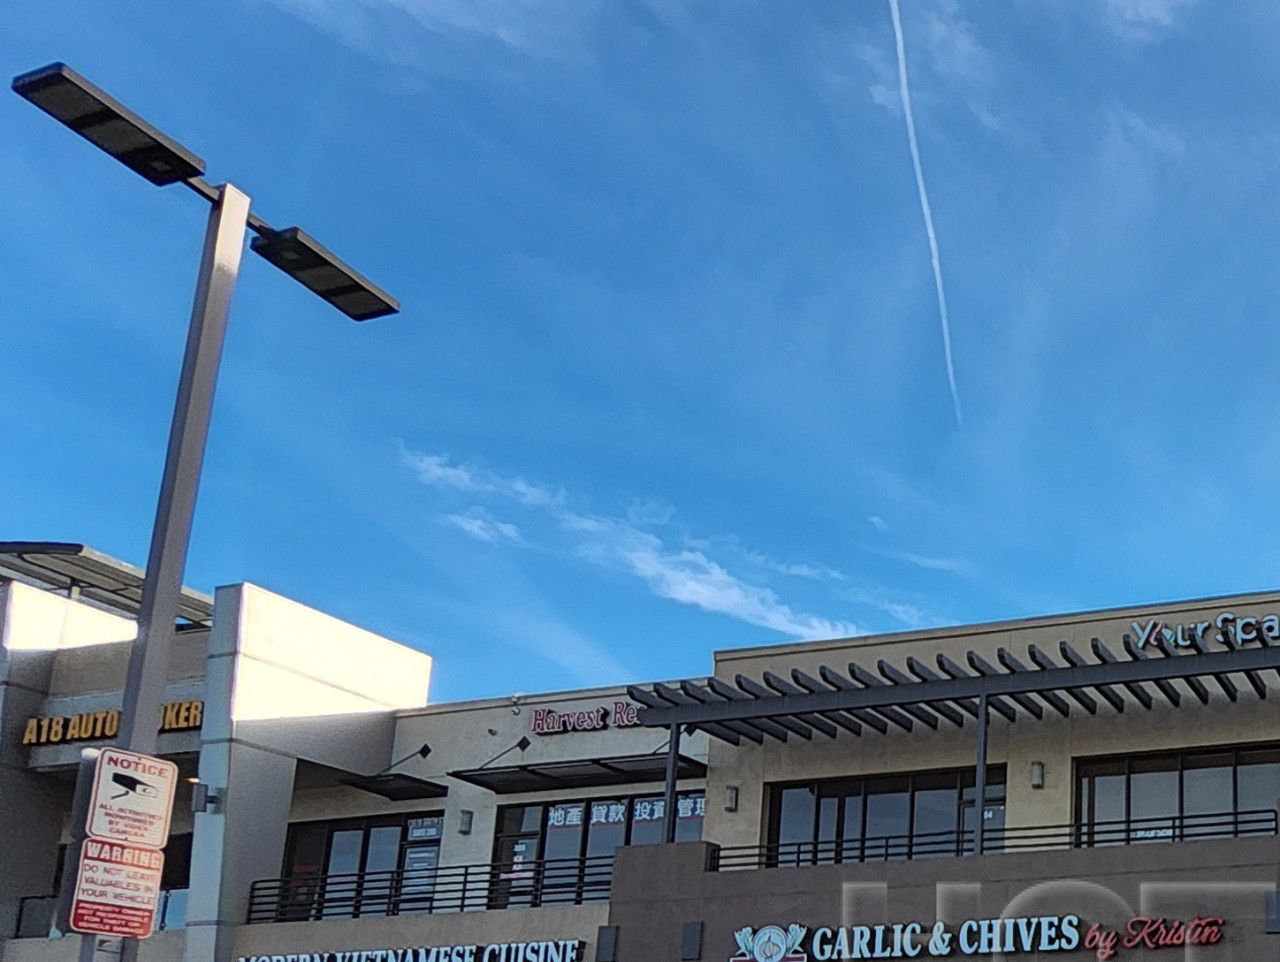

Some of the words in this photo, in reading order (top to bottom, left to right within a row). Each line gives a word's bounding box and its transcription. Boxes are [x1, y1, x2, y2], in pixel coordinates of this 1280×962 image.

[1215, 612, 1280, 646] Spa
[22, 716, 63, 745] A18
[66, 709, 120, 741] AUTO
[160, 701, 202, 730] KER
[531, 706, 604, 733] Harvest
[107, 755, 169, 779] NOTICE
[548, 806, 582, 826] 地產
[590, 804, 625, 823] 貸款
[87, 841, 161, 869] WARNING
[83, 864, 98, 874] DO
[103, 867, 123, 876] NOT
[81, 888, 108, 898] YOUR
[113, 892, 154, 905] VEHICLE
[85, 876, 140, 892] VALUABLES
[812, 921, 923, 962] GARLIC
[929, 920, 952, 956] &
[958, 914, 1080, 956] CHIVES
[1084, 923, 1117, 961] by
[1123, 916, 1224, 949] Kristin
